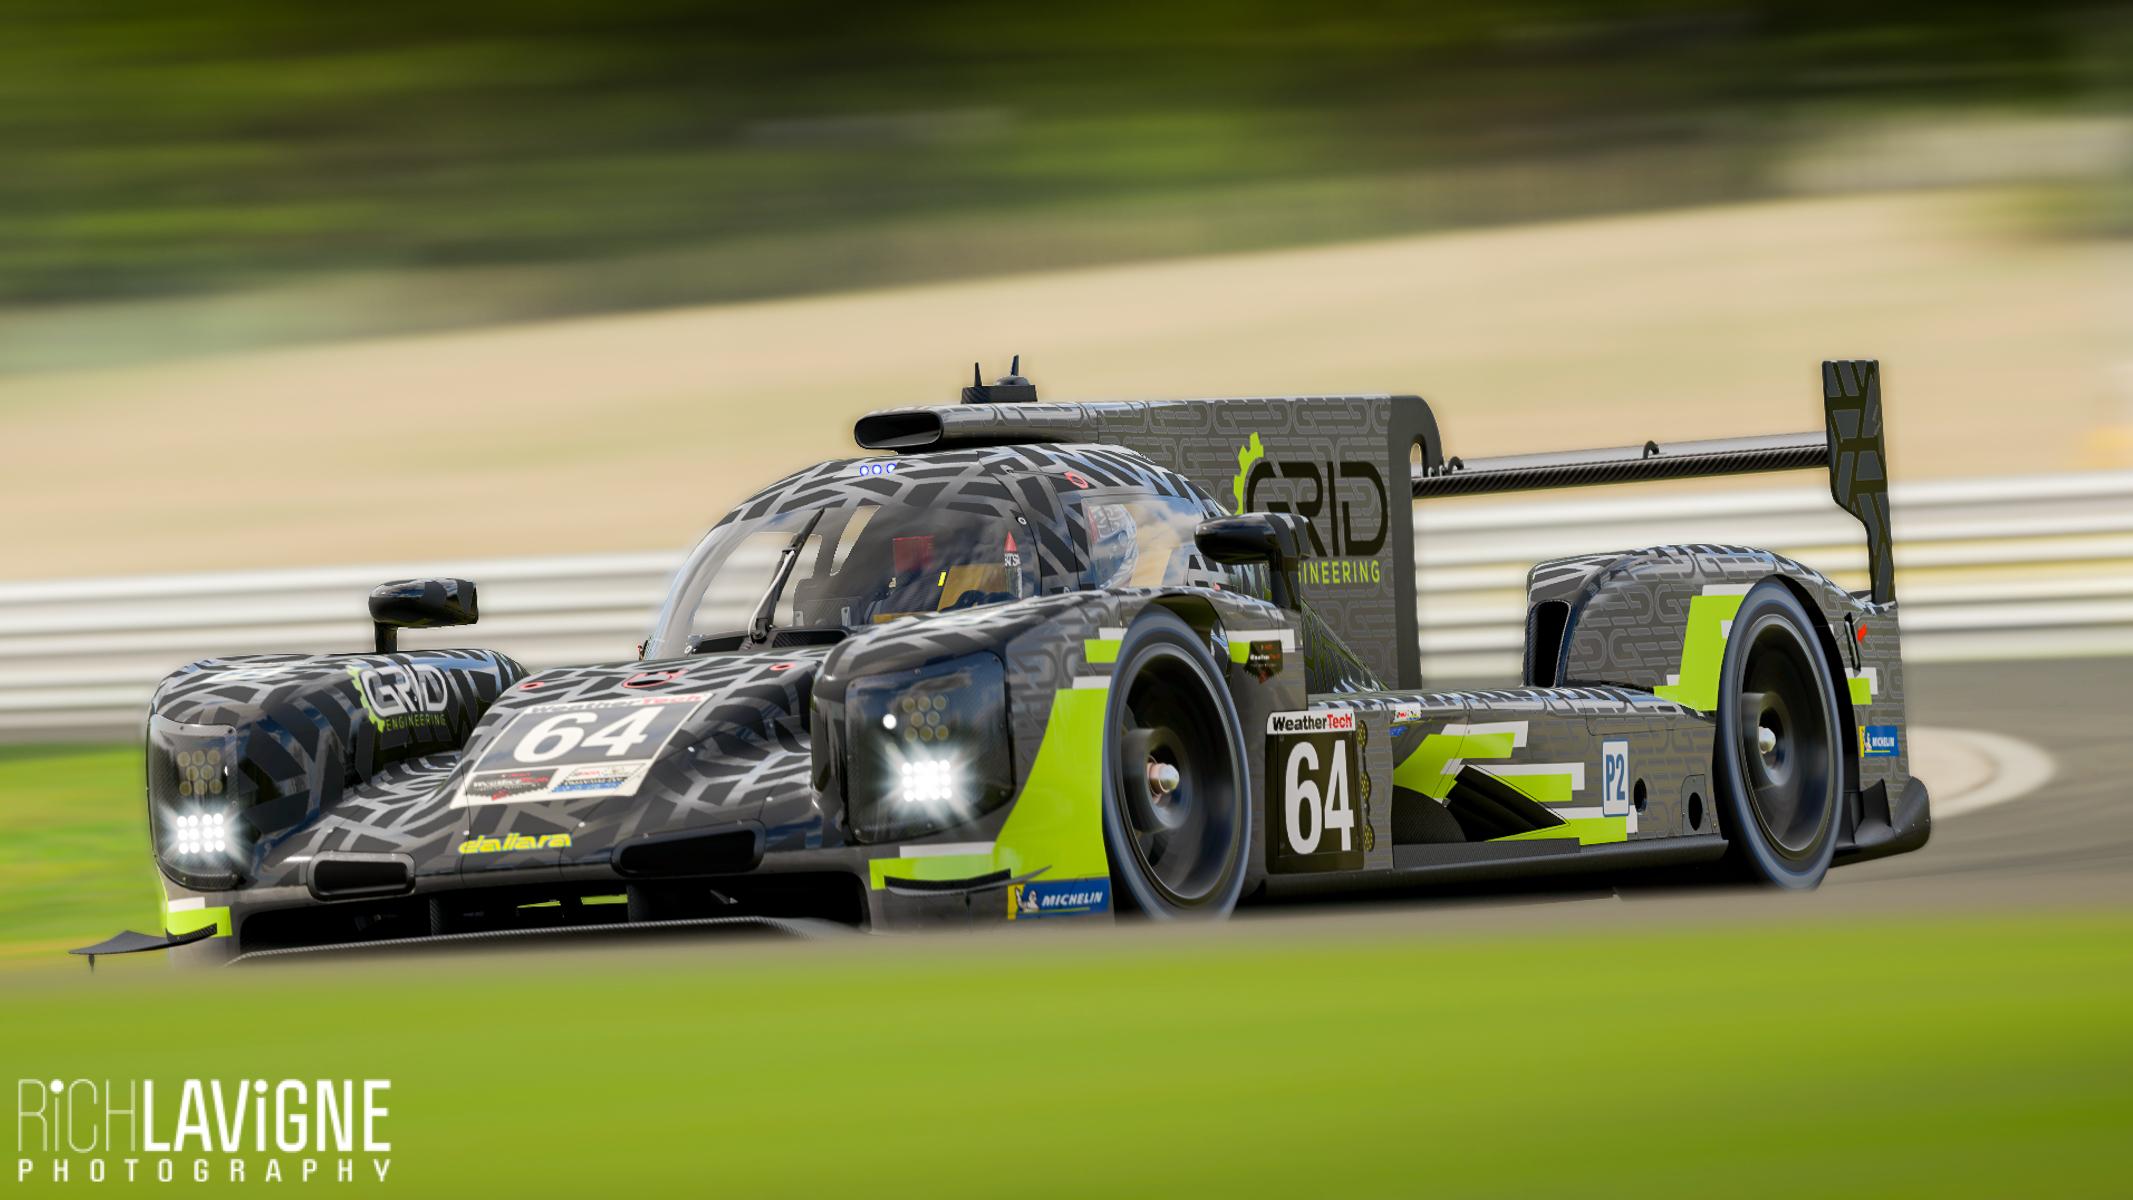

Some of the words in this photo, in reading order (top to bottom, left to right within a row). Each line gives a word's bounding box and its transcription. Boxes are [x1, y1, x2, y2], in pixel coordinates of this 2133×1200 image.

[1298, 559, 1381, 585] INEERING
[360, 664, 448, 717] GRID
[513, 706, 666, 763] 64
[1272, 713, 1353, 731] WeatherTech
[1605, 753, 1626, 801] P2
[1285, 739, 1355, 855] 64
[458, 832, 573, 854] dallara
[1041, 891, 1103, 907] MICHELIN
